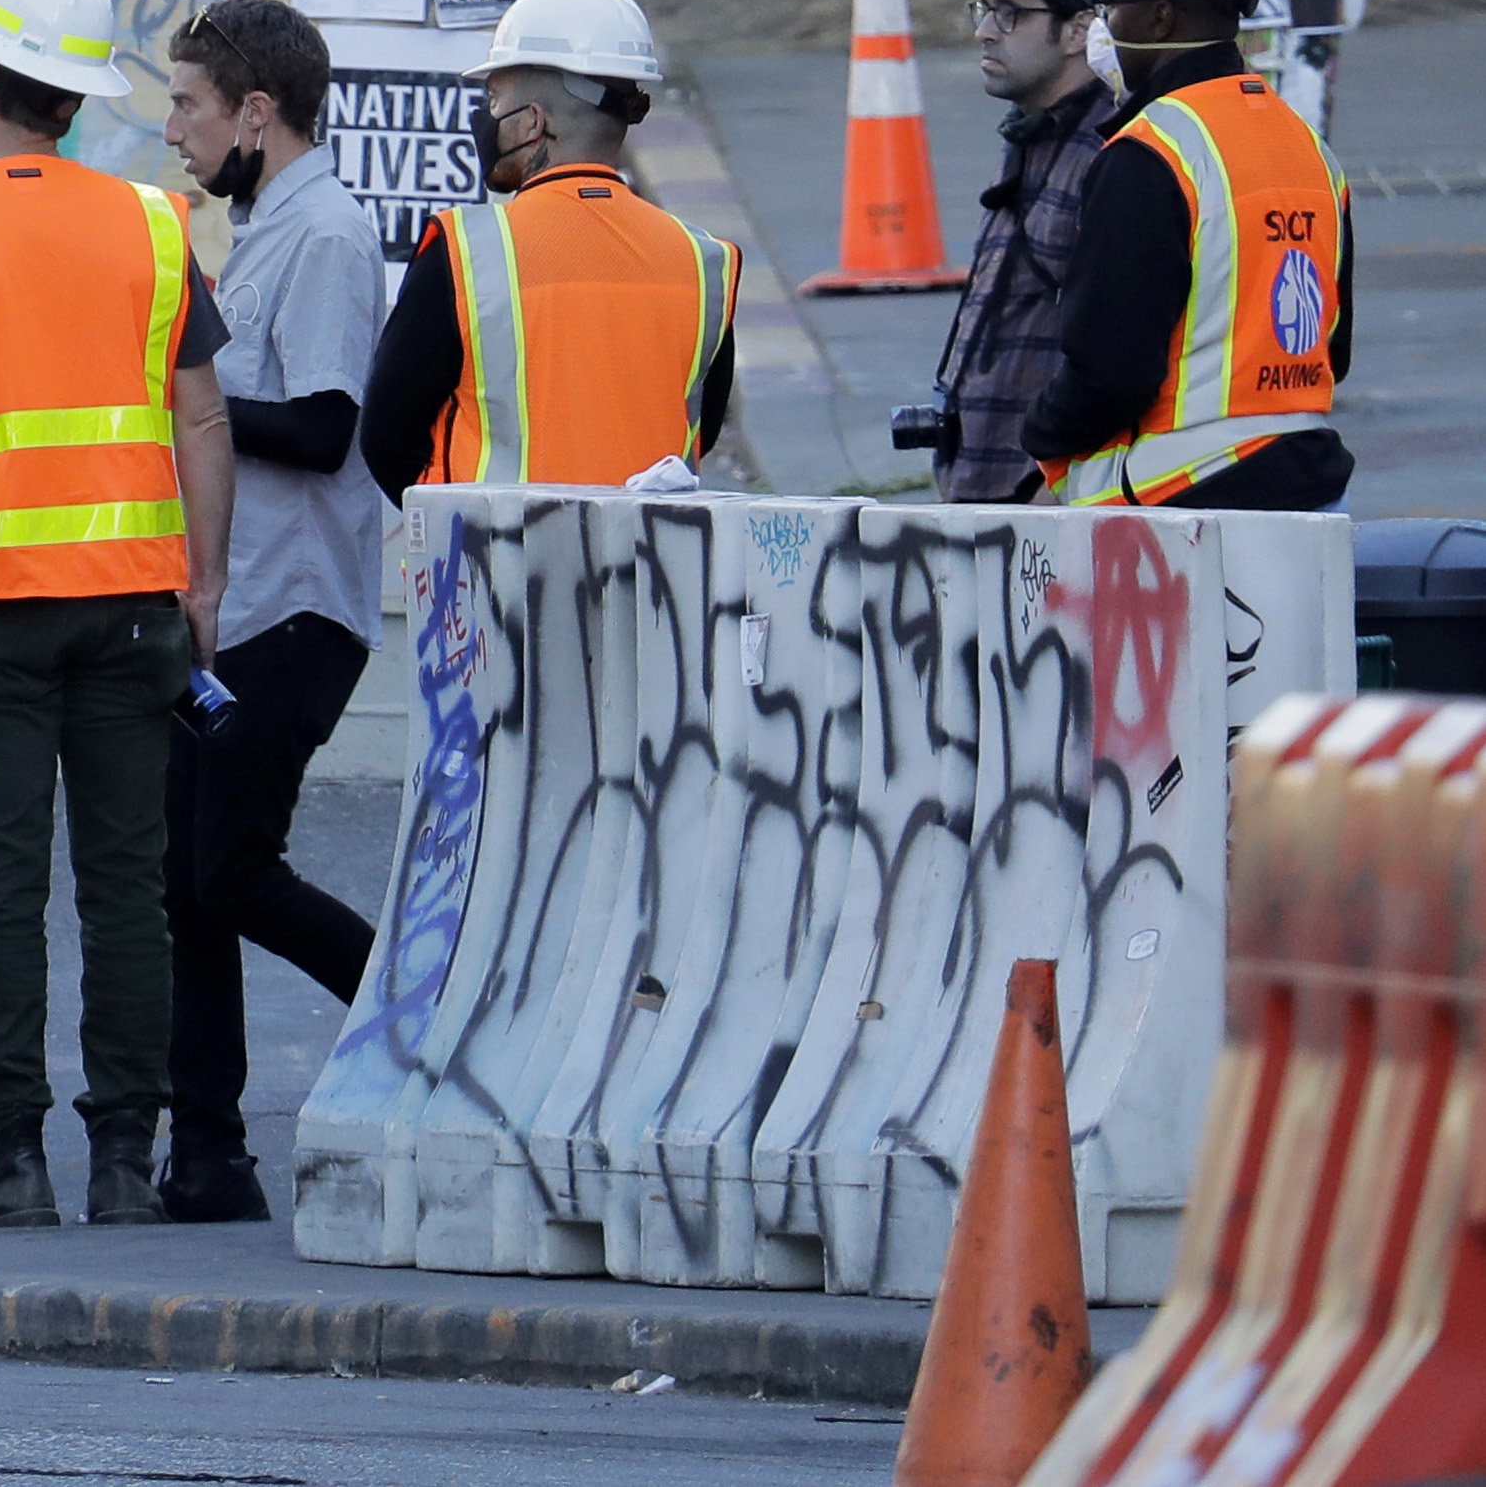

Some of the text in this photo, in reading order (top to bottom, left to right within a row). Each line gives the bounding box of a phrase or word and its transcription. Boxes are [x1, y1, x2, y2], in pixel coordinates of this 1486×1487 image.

[328, 81, 484, 132] NATIVE
[330, 134, 477, 194] LIVES
[1257, 364, 1323, 393] PAVING
